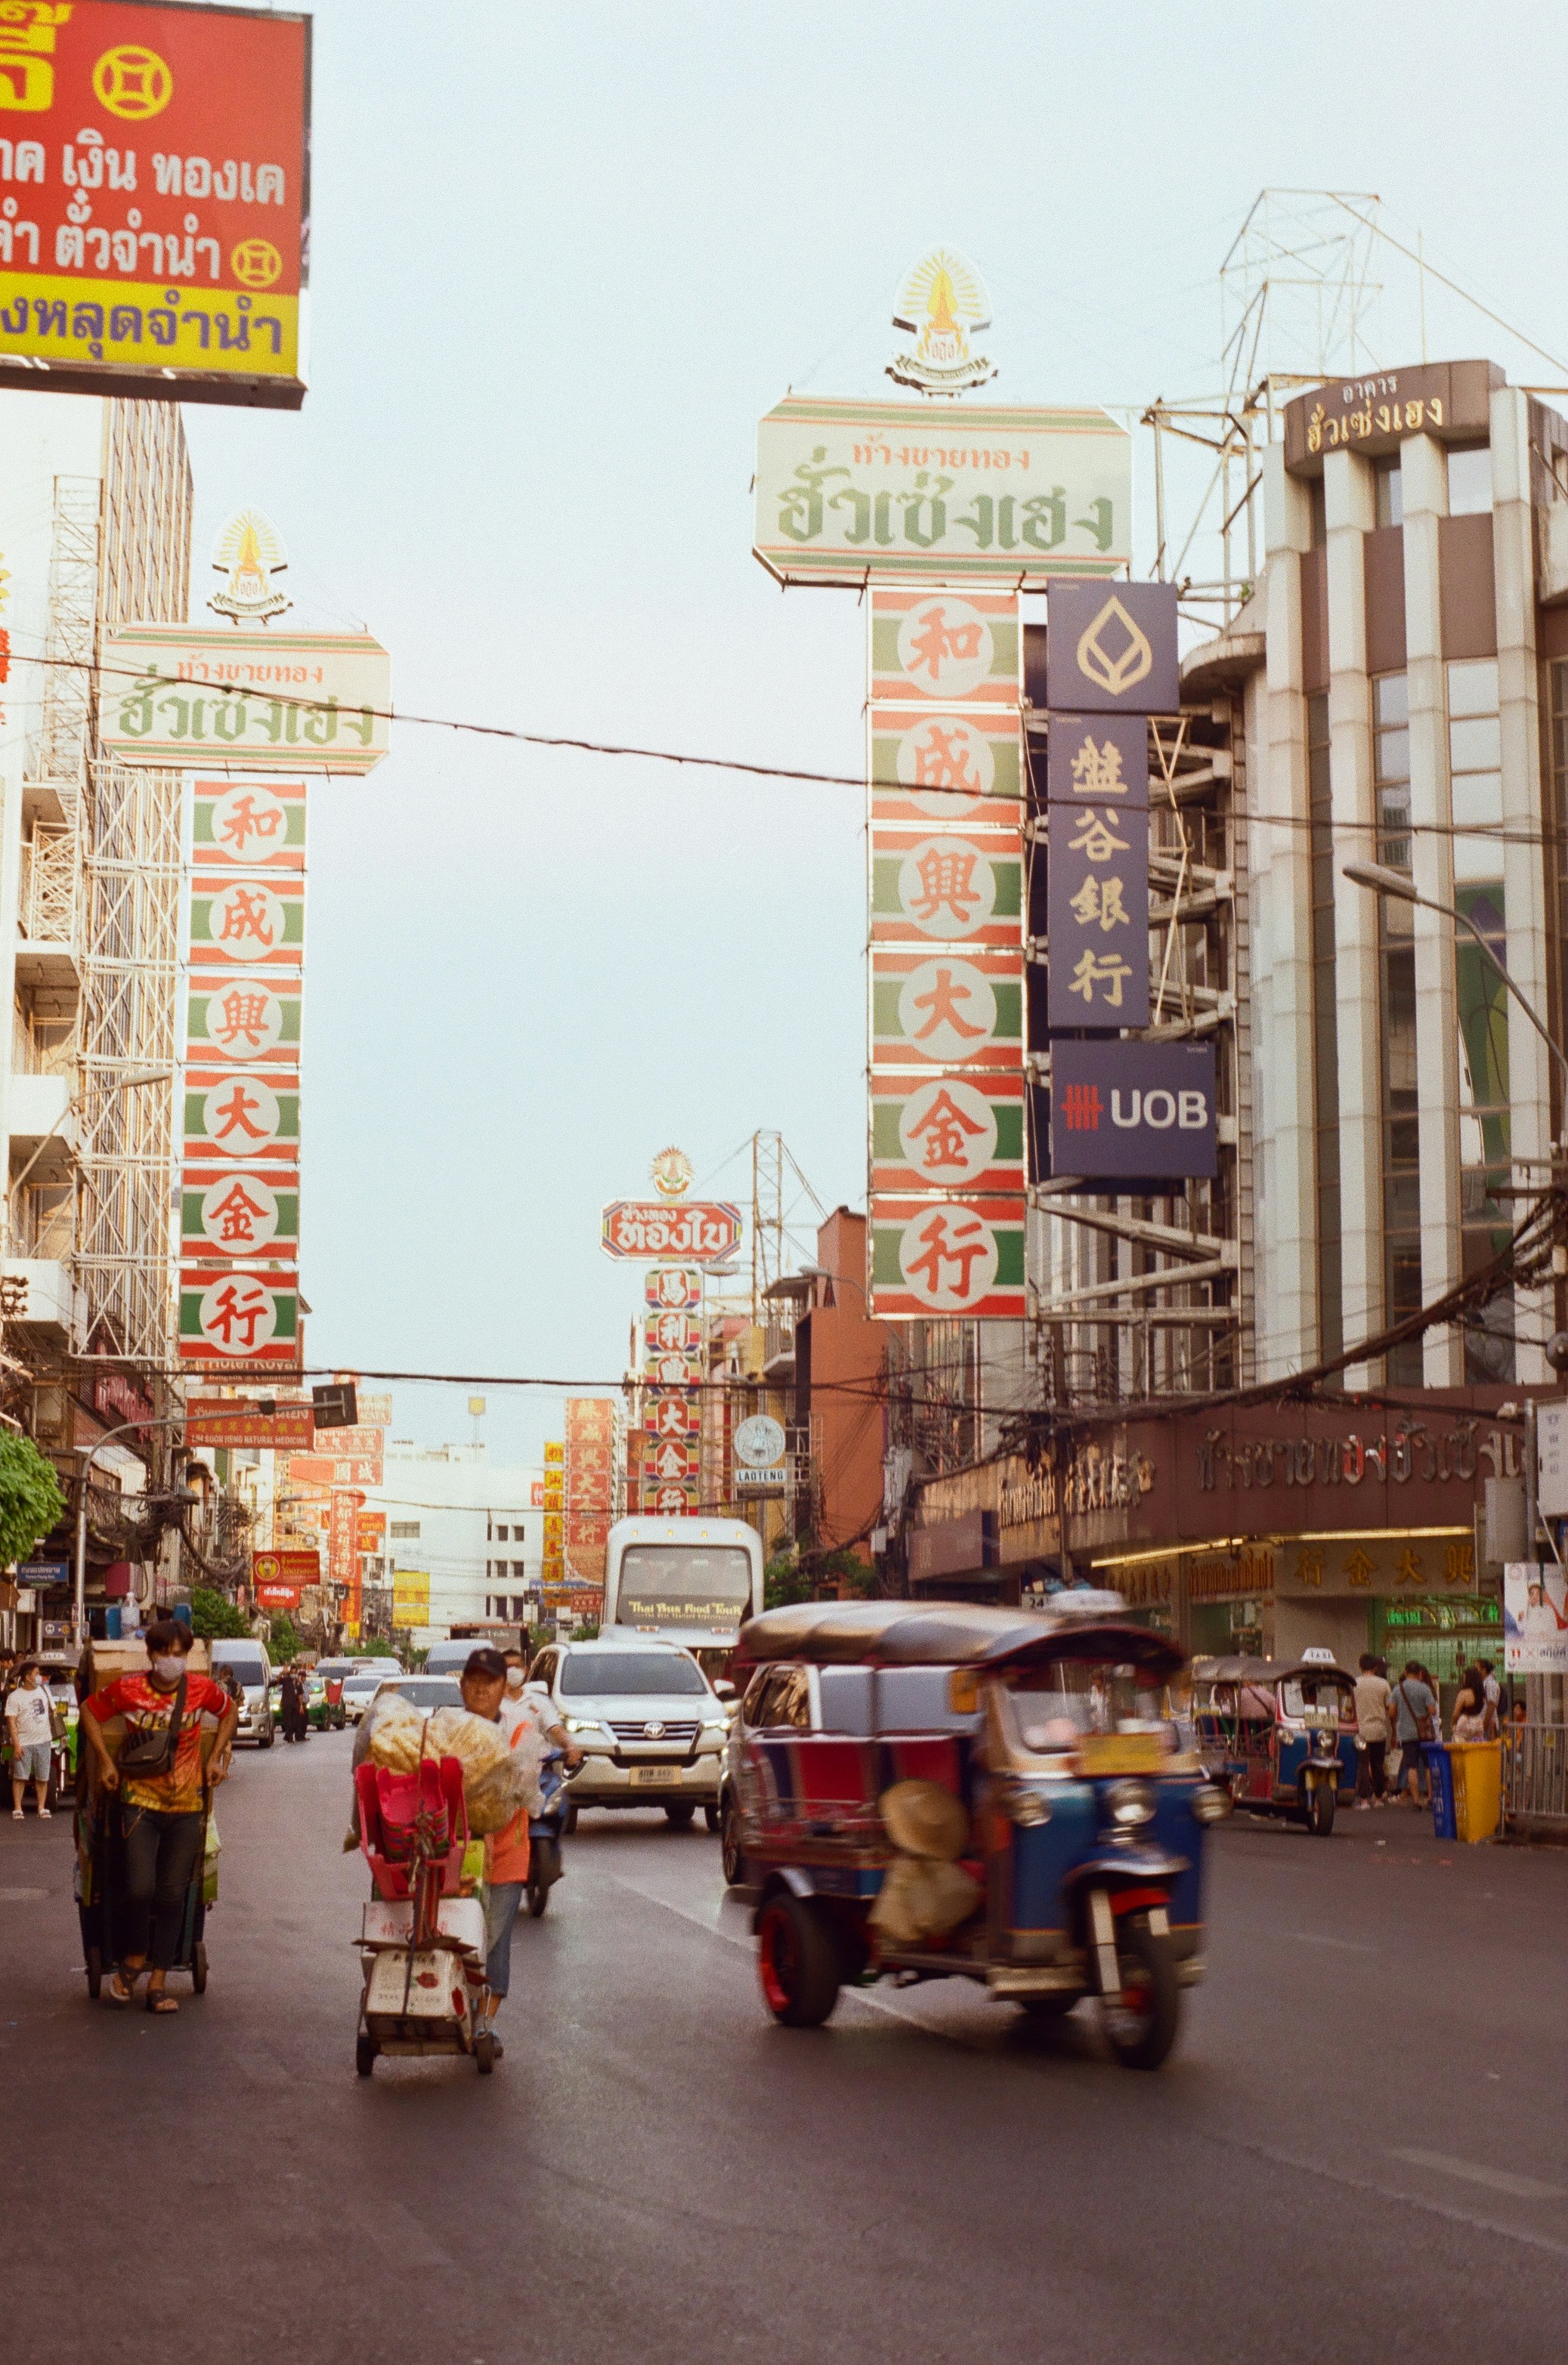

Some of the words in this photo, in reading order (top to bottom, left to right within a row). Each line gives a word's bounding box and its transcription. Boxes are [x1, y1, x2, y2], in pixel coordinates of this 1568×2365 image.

[63, 128, 136, 191] เงิน
[152, 152, 285, 206] ทองเค
[55, 189, 220, 279] ตั๋วจำนำ
[1343, 376, 1397, 403] อาคาร
[852, 434, 1030, 470] ห้างขายทอง
[1111, 1089, 1208, 1130] UOB
[617, 1209, 728, 1251] ทองใบ
[275, 1437, 308, 1445] MEDICINE
